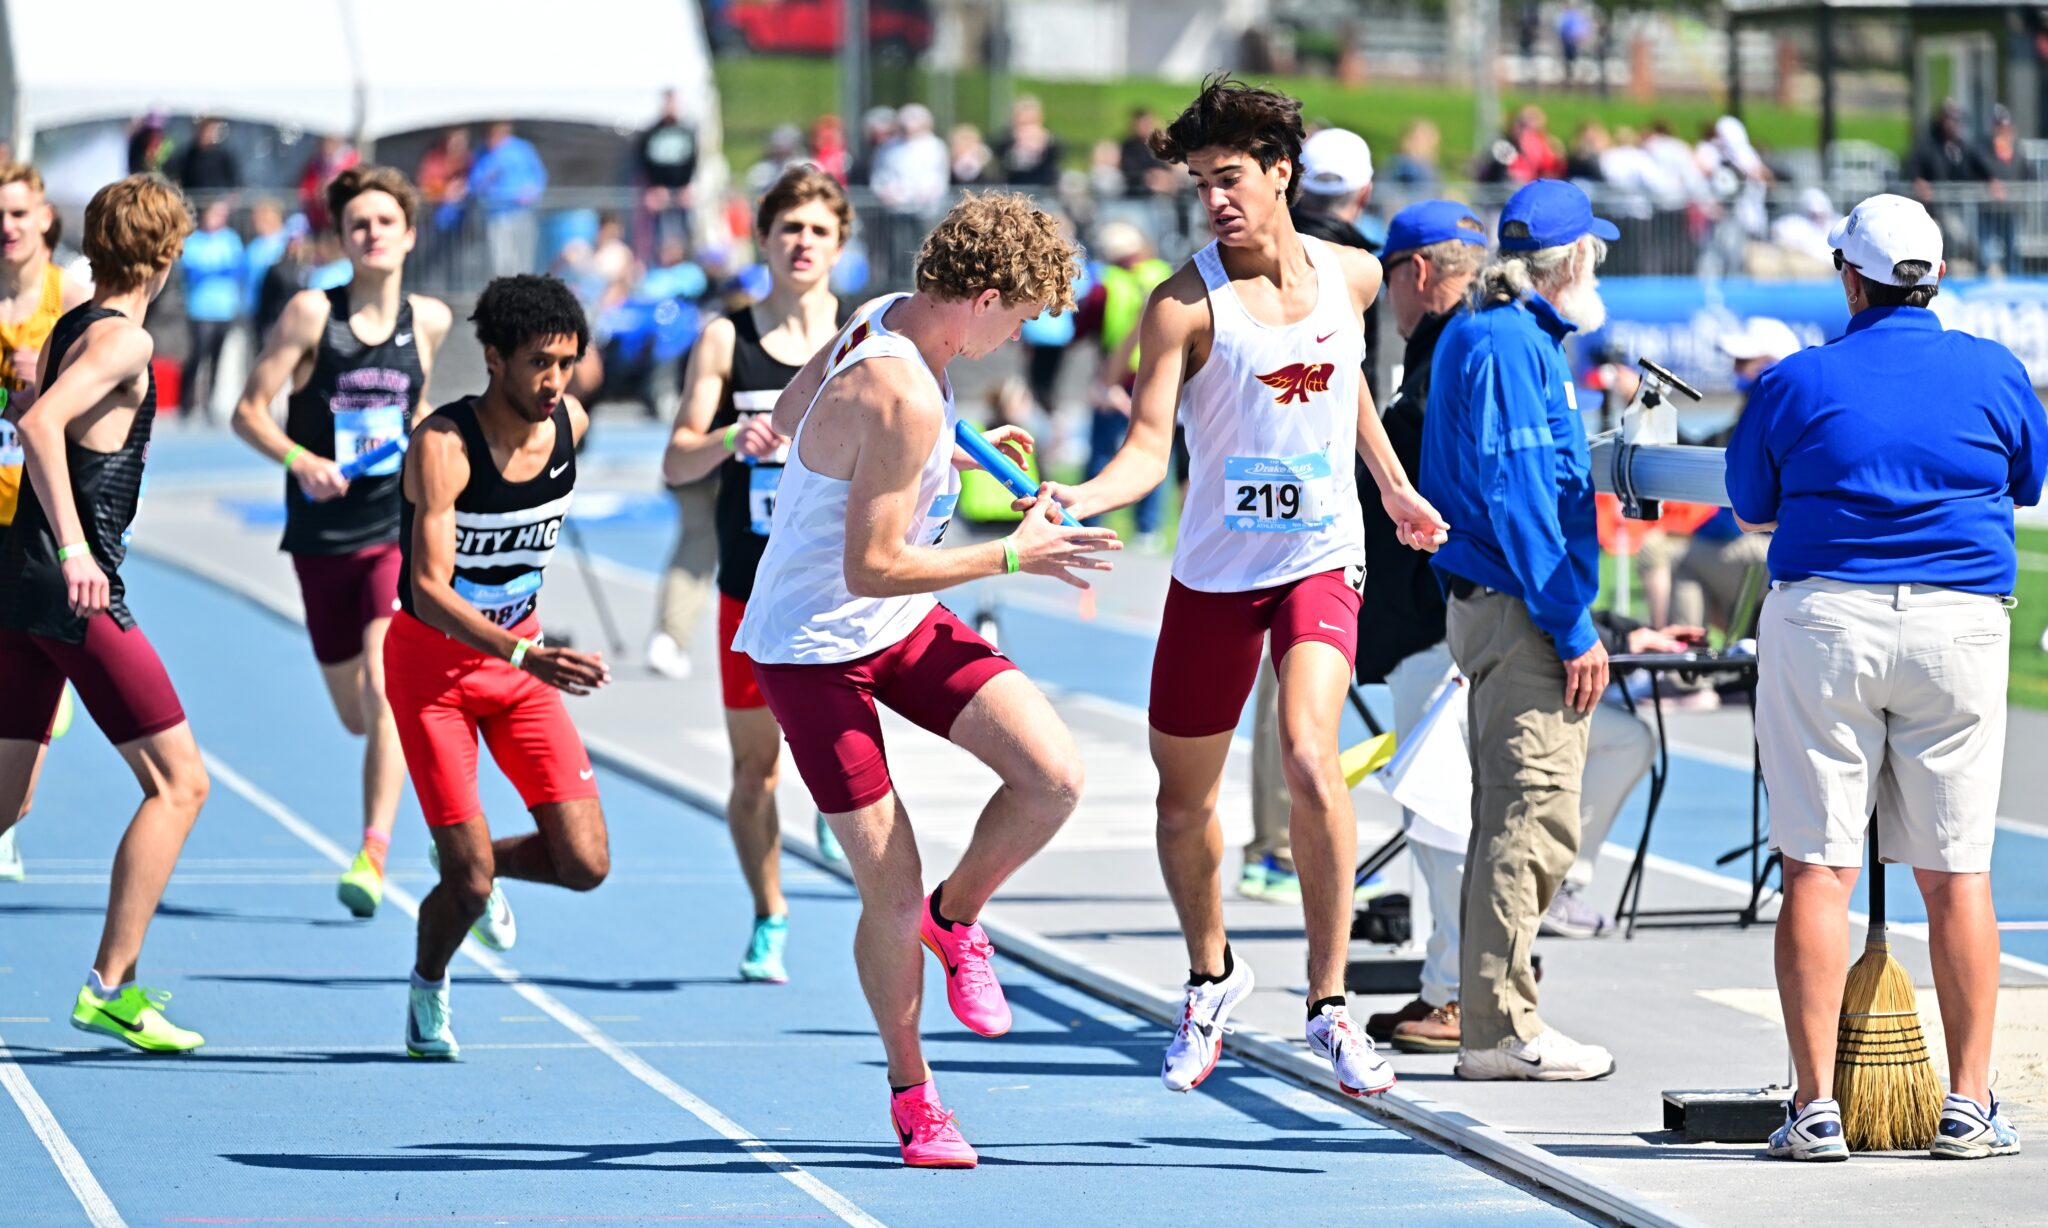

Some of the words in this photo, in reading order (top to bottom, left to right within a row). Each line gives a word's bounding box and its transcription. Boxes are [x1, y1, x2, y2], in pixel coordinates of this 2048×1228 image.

[1253, 463, 1286, 473] Drake
[1237, 483, 1300, 520] 219
[456, 529, 512, 553] CITY
